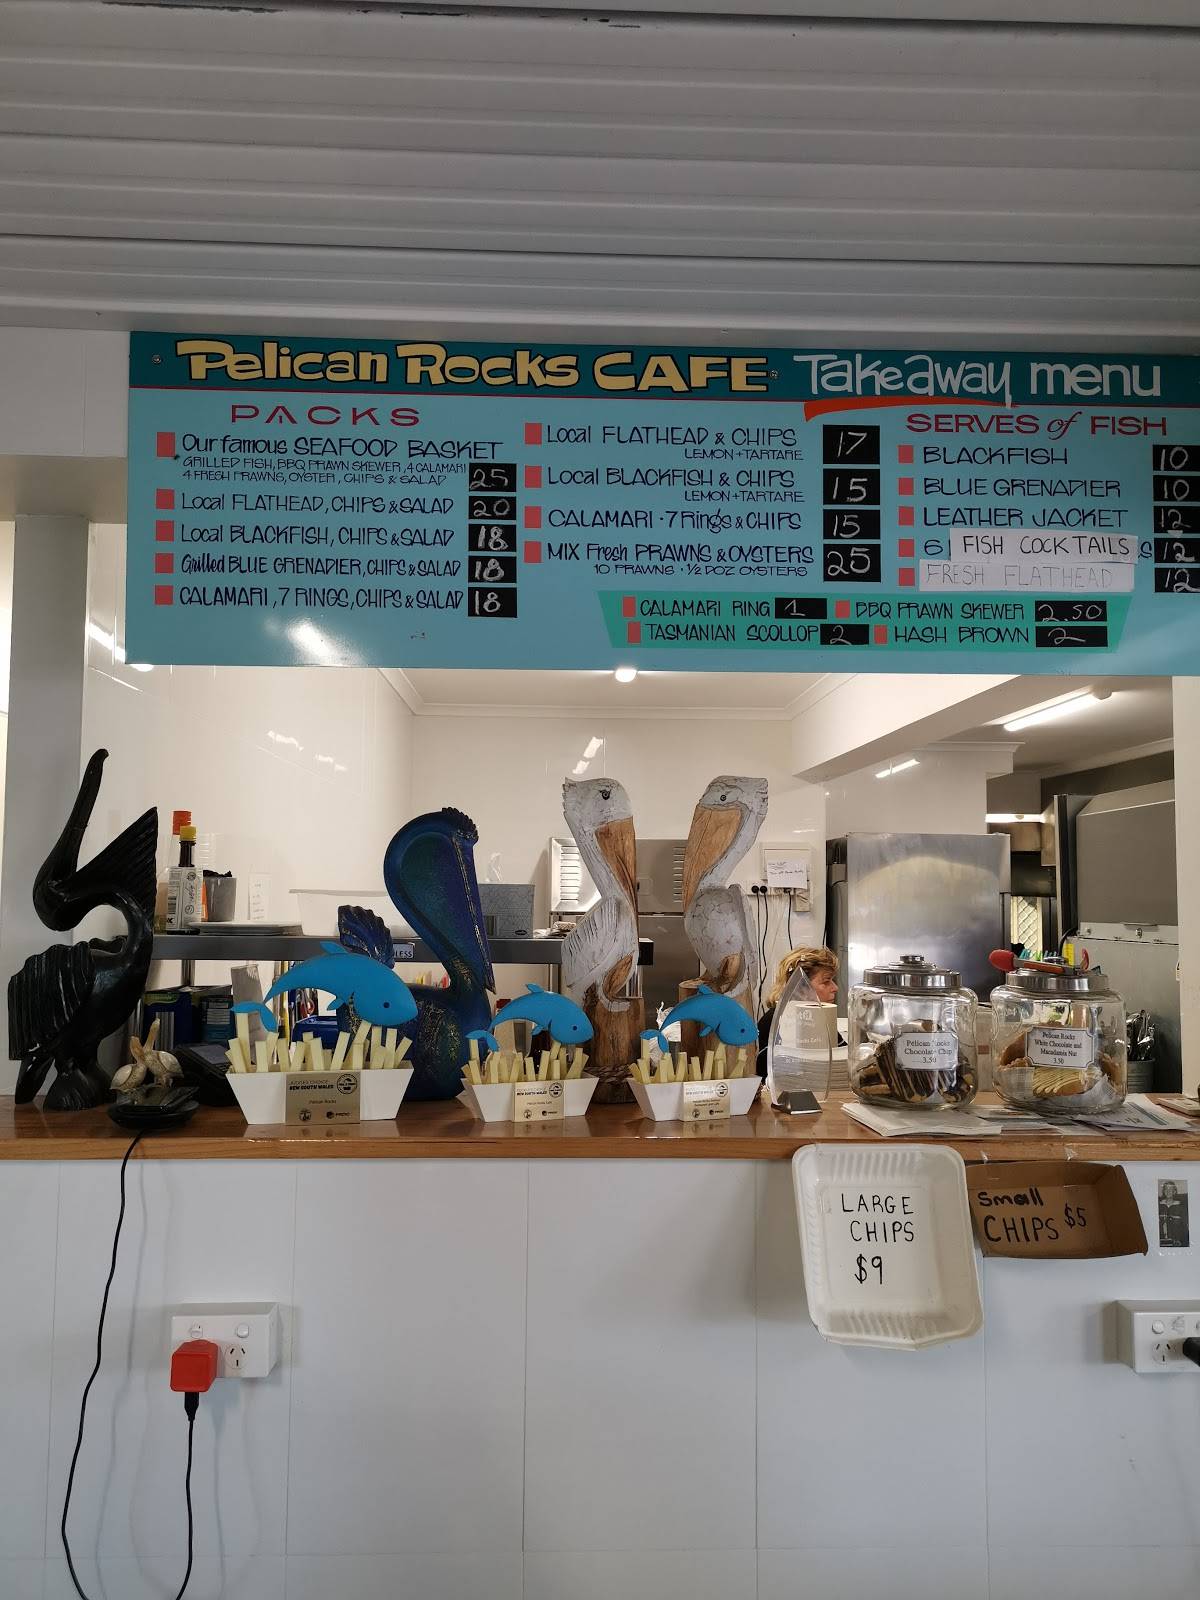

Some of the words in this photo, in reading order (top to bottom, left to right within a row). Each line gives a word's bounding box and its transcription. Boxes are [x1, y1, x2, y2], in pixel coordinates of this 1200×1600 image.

[175, 339, 389, 383] Pelican
[396, 343, 580, 387] Rocks
[593, 351, 769, 393] CAFE
[1030, 362, 1161, 397] menu
[231, 404, 421, 427] PACKS
[907, 413, 1039, 434] SERVES
[1047, 411, 1082, 440] of
[1091, 416, 1167, 436] FISH
[547, 425, 591, 443] Local
[603, 426, 709, 445] FLATHEAD
[715, 432, 725, 445] &
[732, 427, 797, 446] CHIPS
[837, 431, 867, 458] 17
[182, 434, 218, 452] Our
[220, 435, 288, 454] famous
[294, 437, 398, 458] SEAFOOD
[408, 440, 504, 459] BASKET
[923, 447, 1068, 465] BLACKFISH
[183, 456, 240, 468] GRILLED
[277, 460, 306, 471] BBQ
[308, 460, 349, 471] PRAWN
[416, 463, 466, 473] CALAMARI
[1160, 446, 1189, 471] 10
[182, 470, 192, 480] 4
[194, 471, 229, 481] FRESH
[344, 473, 384, 484] CHIPS
[388, 476, 397, 484] &
[400, 475, 446, 486] SALAD
[470, 468, 508, 489] 25
[548, 467, 599, 485] Local
[606, 467, 713, 487] BLACKFISH
[719, 472, 730, 486] &
[737, 470, 794, 487] CHIPS
[833, 477, 868, 502] 15
[924, 478, 988, 496] BLUE
[993, 478, 1121, 498] GRENADIER
[1164, 479, 1190, 500] 10
[182, 493, 225, 510] Local
[331, 496, 386, 513] CHIPS
[473, 499, 511, 517] 20
[548, 509, 653, 528] CALAMARI
[681, 509, 732, 534] Rings
[746, 512, 801, 530] CHIPS
[833, 514, 861, 538] 15
[924, 507, 1023, 526] LEATHER
[1032, 508, 1128, 528] JACKET
[1160, 508, 1192, 529] 12
[181, 524, 223, 542] Local
[338, 527, 387, 545] CHIPS
[477, 526, 508, 550] 18
[547, 543, 580, 560] MIX
[586, 543, 628, 561] Fresh
[635, 543, 712, 562] PRAWNS
[728, 545, 814, 564] OYSTERS
[924, 539, 943, 556] 6
[962, 536, 1004, 555] FISH
[1164, 542, 1195, 562] 12
[181, 553, 225, 575] Grilled
[229, 556, 268, 573] BLUE
[367, 559, 406, 576] CHIPS
[475, 558, 505, 582] 18
[594, 564, 610, 574] 10
[615, 564, 675, 575] PRAWNS
[705, 566, 735, 575] DOZ
[739, 566, 808, 576] OYSTERS
[827, 547, 871, 576] 25
[927, 564, 984, 586] FRESH
[1004, 565, 1113, 588] FLATHEAD
[1165, 569, 1200, 592] 12
[356, 589, 402, 608] CHIPS
[475, 590, 501, 615] 18
[640, 600, 721, 617] CALAMARI
[733, 600, 771, 617] RING
[784, 600, 806, 617] 1
[856, 602, 891, 619] BBQ
[898, 602, 953, 620] PRAWN
[960, 603, 1024, 620] SKEWER
[1038, 604, 1102, 622] 2.50
[645, 623, 736, 641] TASMANIAN
[747, 625, 818, 642] SCOLLOP
[830, 625, 852, 645] 2
[895, 626, 947, 643] HASH
[959, 627, 1029, 644] BROWN
[1048, 627, 1086, 644] 2
[906, 1039, 930, 1047] Pelican
[841, 1193, 914, 1215] LARGE
[977, 1187, 1045, 1208] Small
[850, 1220, 915, 1243] CHIPS
[983, 1214, 1059, 1244] CHIPS
[1064, 1203, 1087, 1229] $5
[854, 1253, 884, 1285] $9
